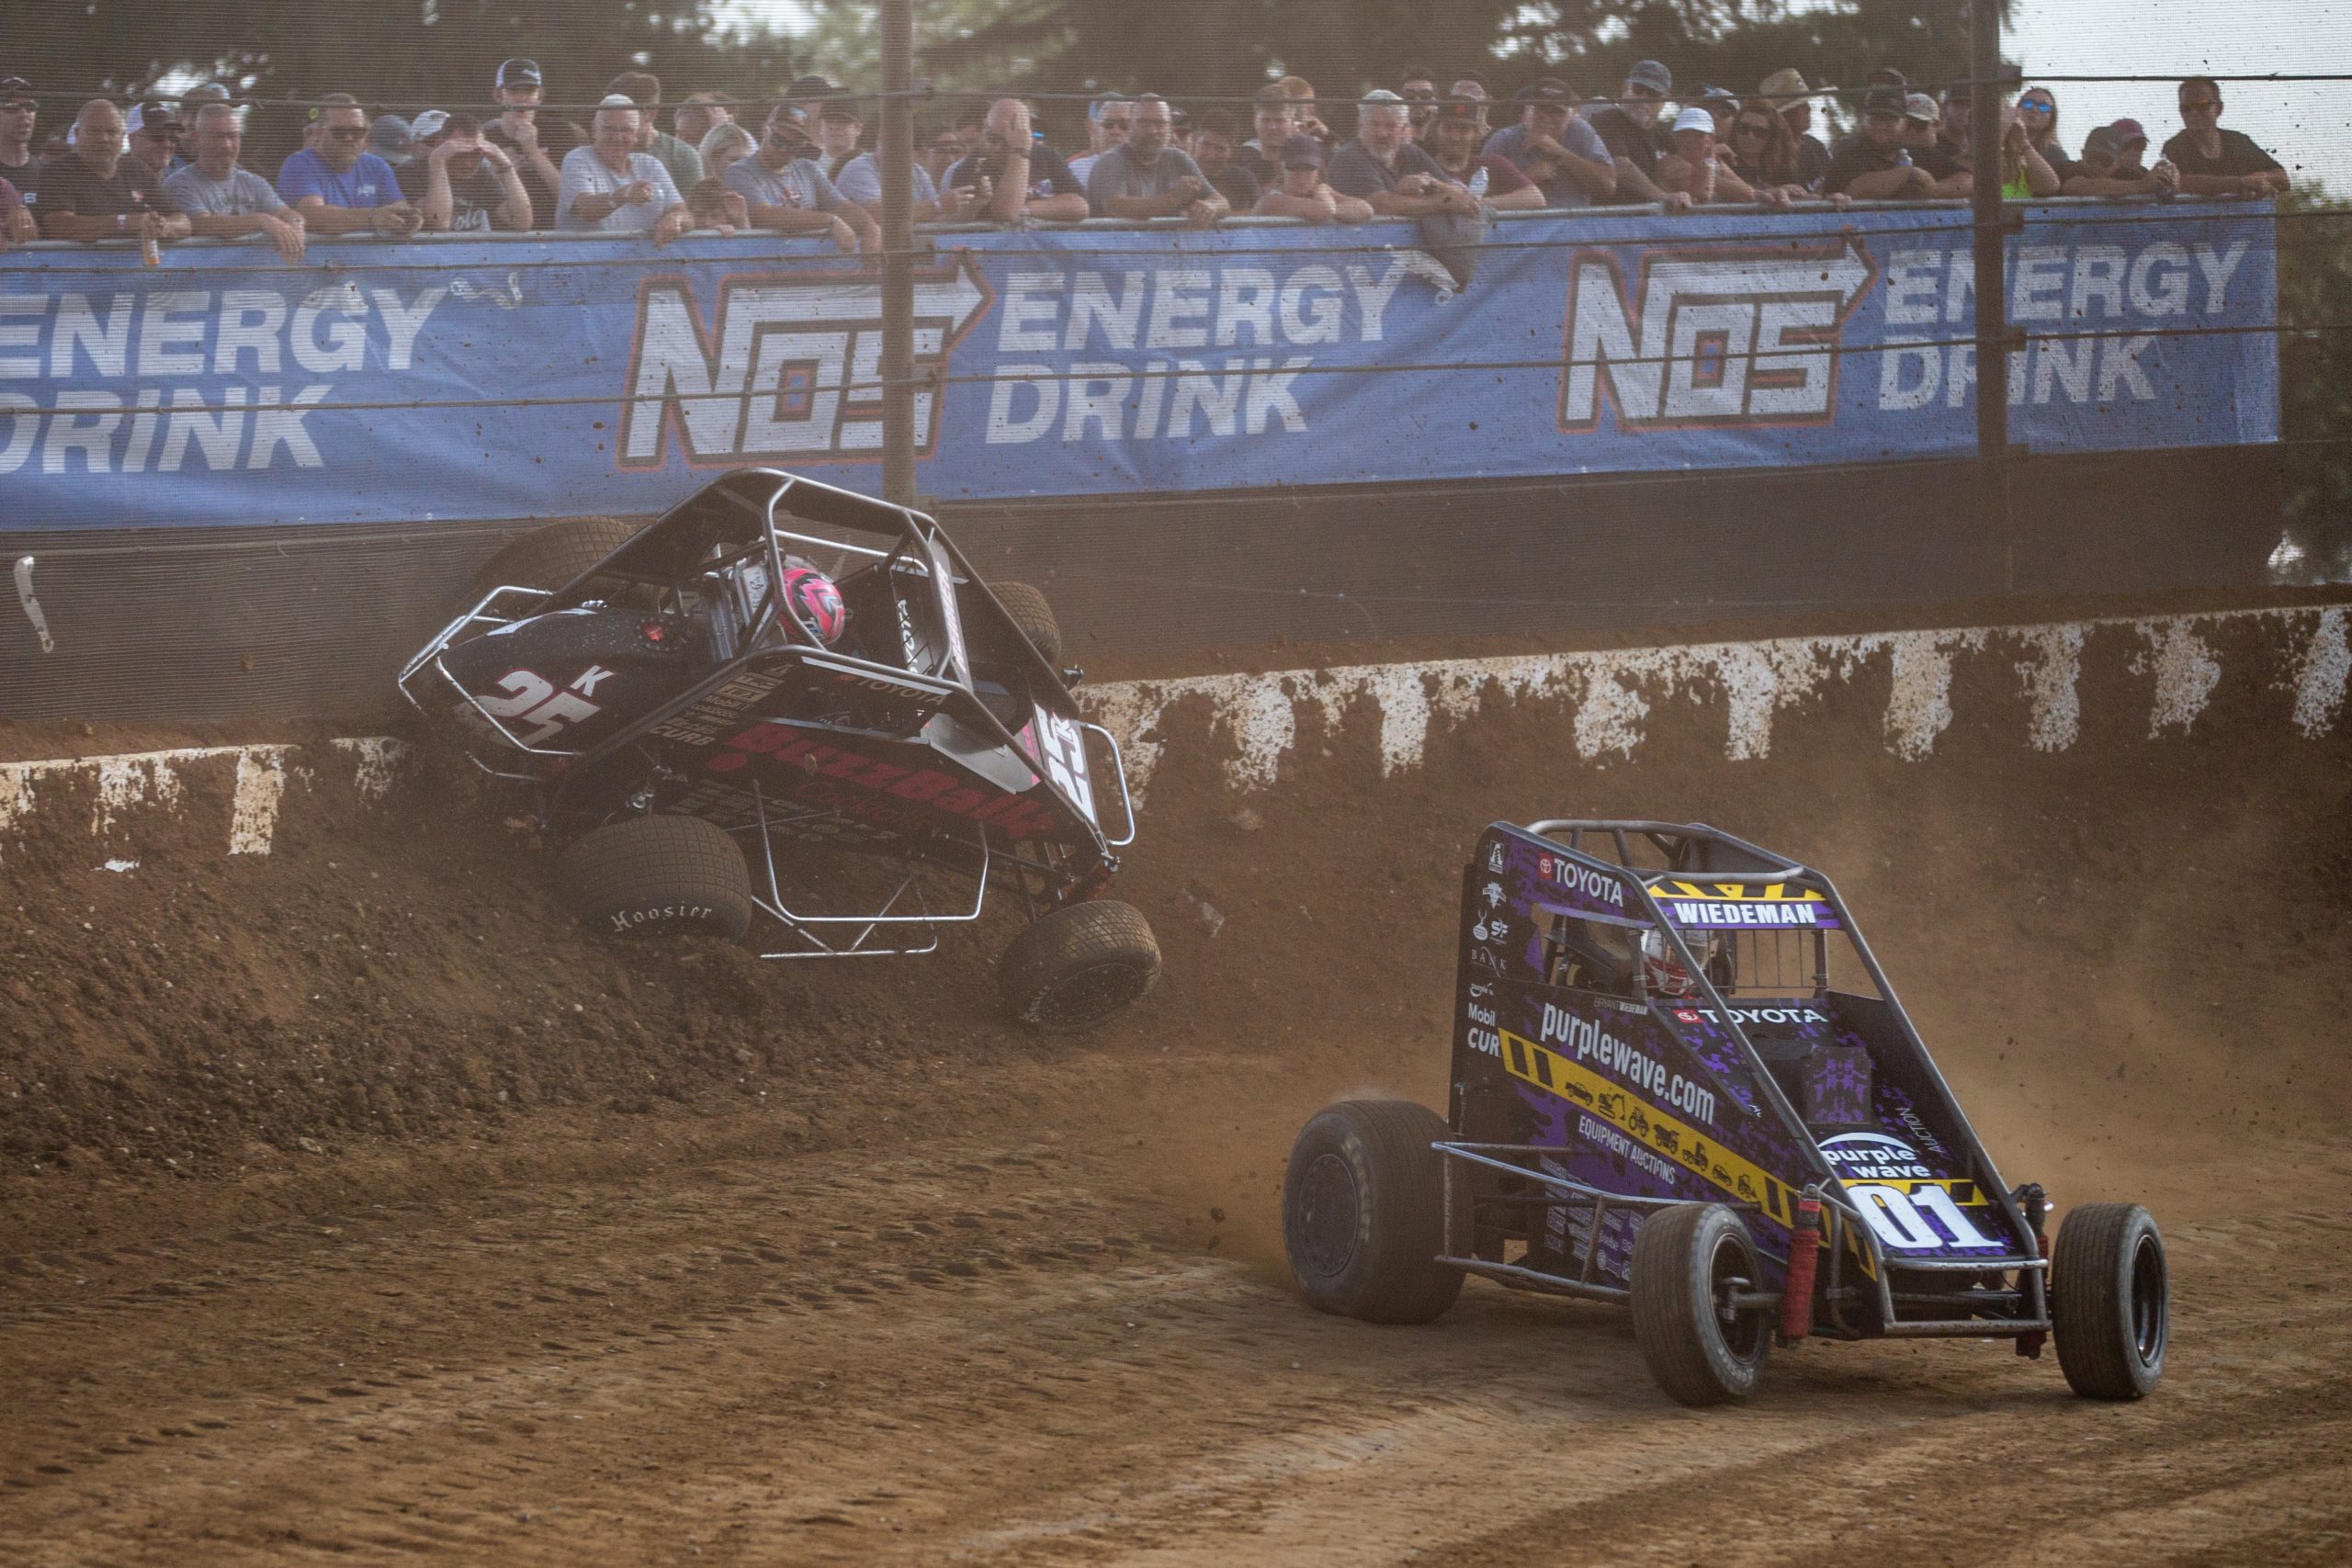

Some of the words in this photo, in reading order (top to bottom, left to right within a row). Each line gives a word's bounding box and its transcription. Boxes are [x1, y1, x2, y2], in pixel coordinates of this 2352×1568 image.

[0, 287, 448, 379] ENERGY
[997, 263, 1399, 353] ENERGY
[1559, 248, 1842, 434] NOS
[619, 276, 960, 467] NOS
[985, 356, 1314, 445] DRINK
[897, 599, 919, 674] YOTA
[854, 677, 950, 706] TOYOTA
[1554, 858, 1624, 908] TOYOTA
[610, 899, 713, 933] Hoosier
[1673, 901, 1816, 925] WIEDEMAN
[1468, 1002, 1496, 1027] Mobil
[1698, 1009, 1828, 1023] TOYOTA
[1467, 1027, 1501, 1058] CUR
[1540, 1002, 1715, 1125] purplewave.com
[1578, 1115, 1631, 1158] EQUIPMENT
[1630, 1149, 1676, 1186] AUCTIONS
[1822, 1145, 1917, 1167] purple
[1895, 1107, 1949, 1155] AUCTION
[1852, 1164, 1931, 1179] wave
[1847, 1185, 2005, 1248] 01
